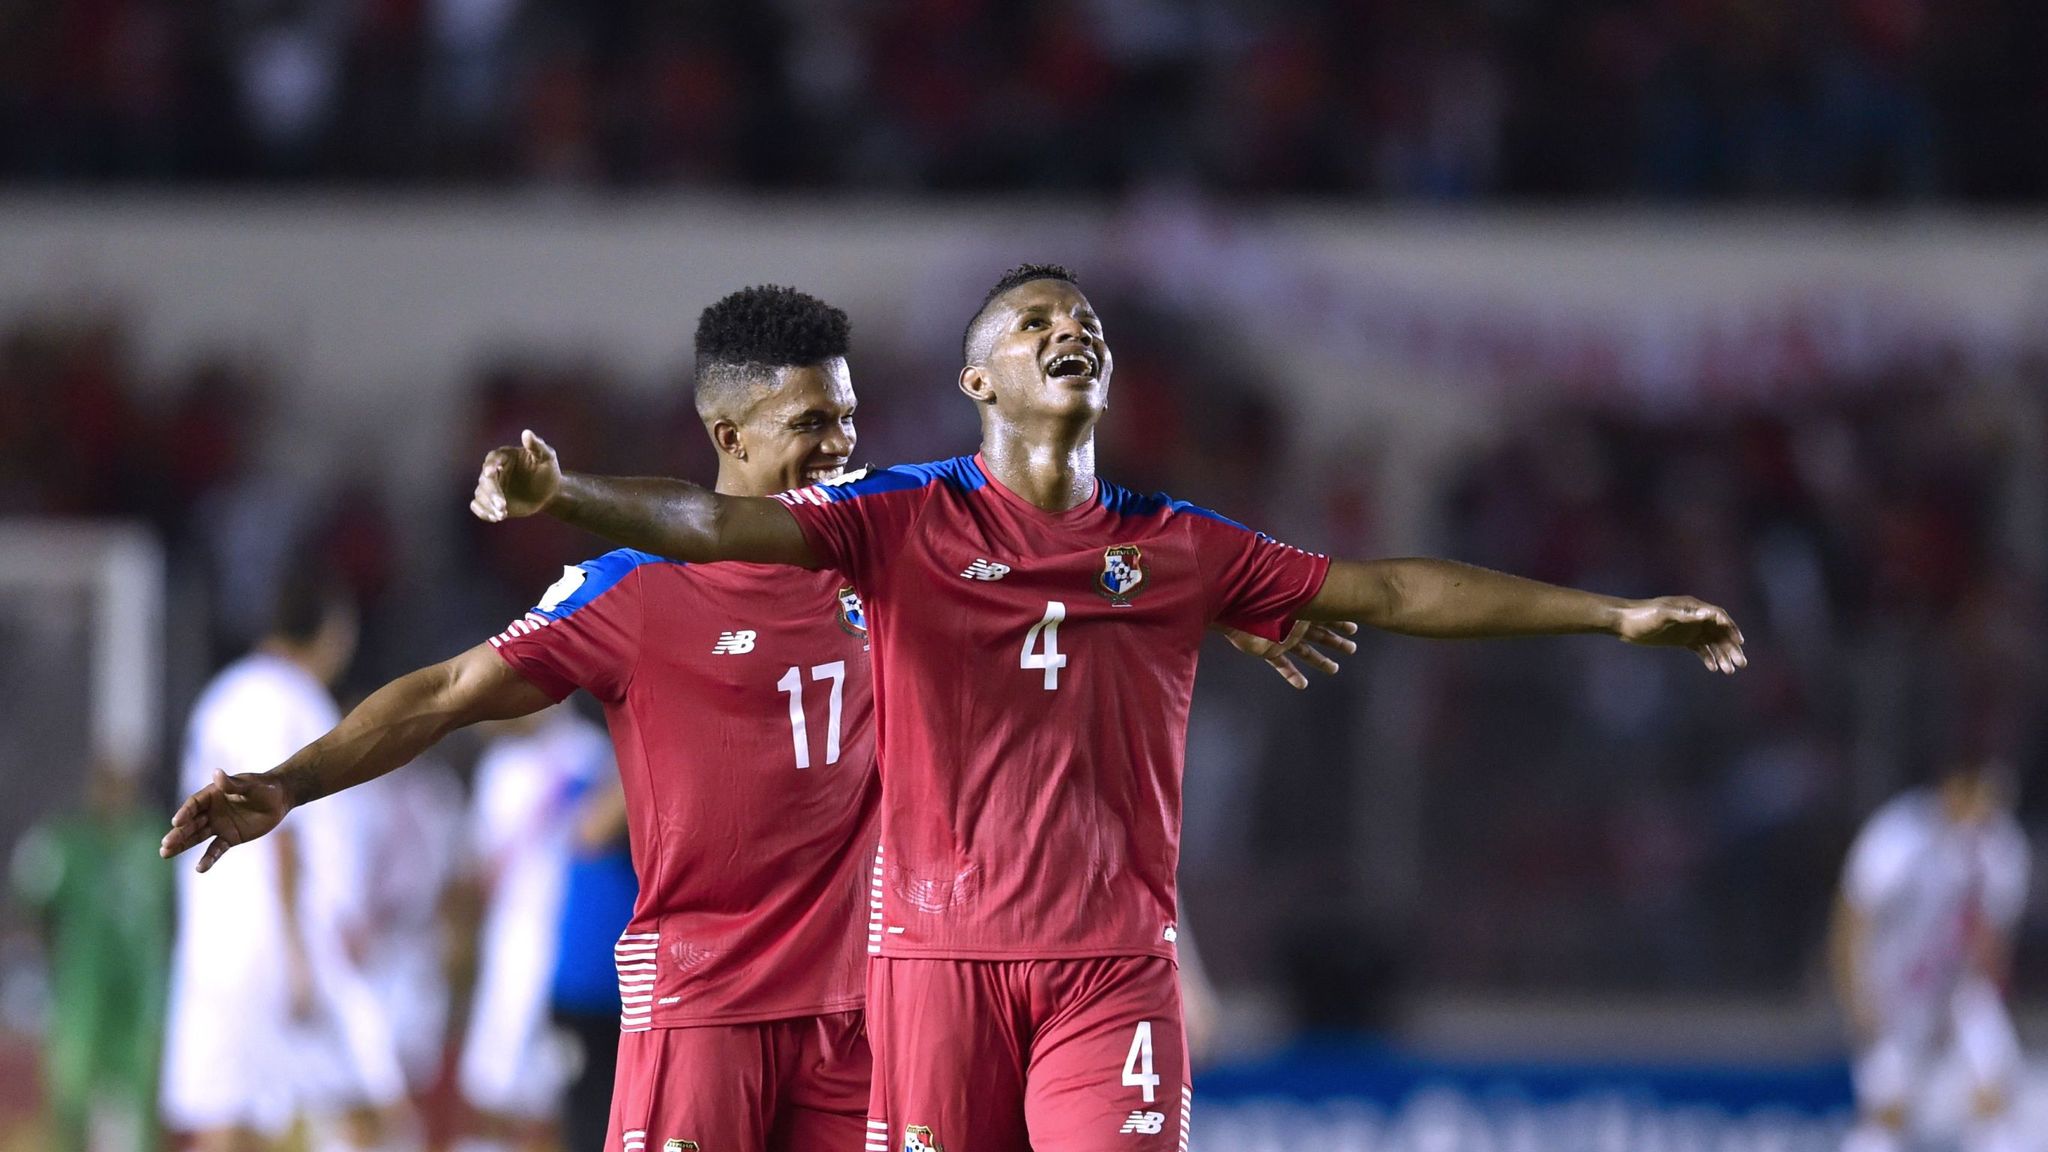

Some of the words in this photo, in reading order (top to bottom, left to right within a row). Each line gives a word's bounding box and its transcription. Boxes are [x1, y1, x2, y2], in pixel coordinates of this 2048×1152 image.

[711, 629, 757, 655] NB
[1020, 600, 1067, 690] 4
[777, 660, 846, 769] 17
[1121, 1021, 1160, 1103] 4
[1119, 1110, 1166, 1135] NB
